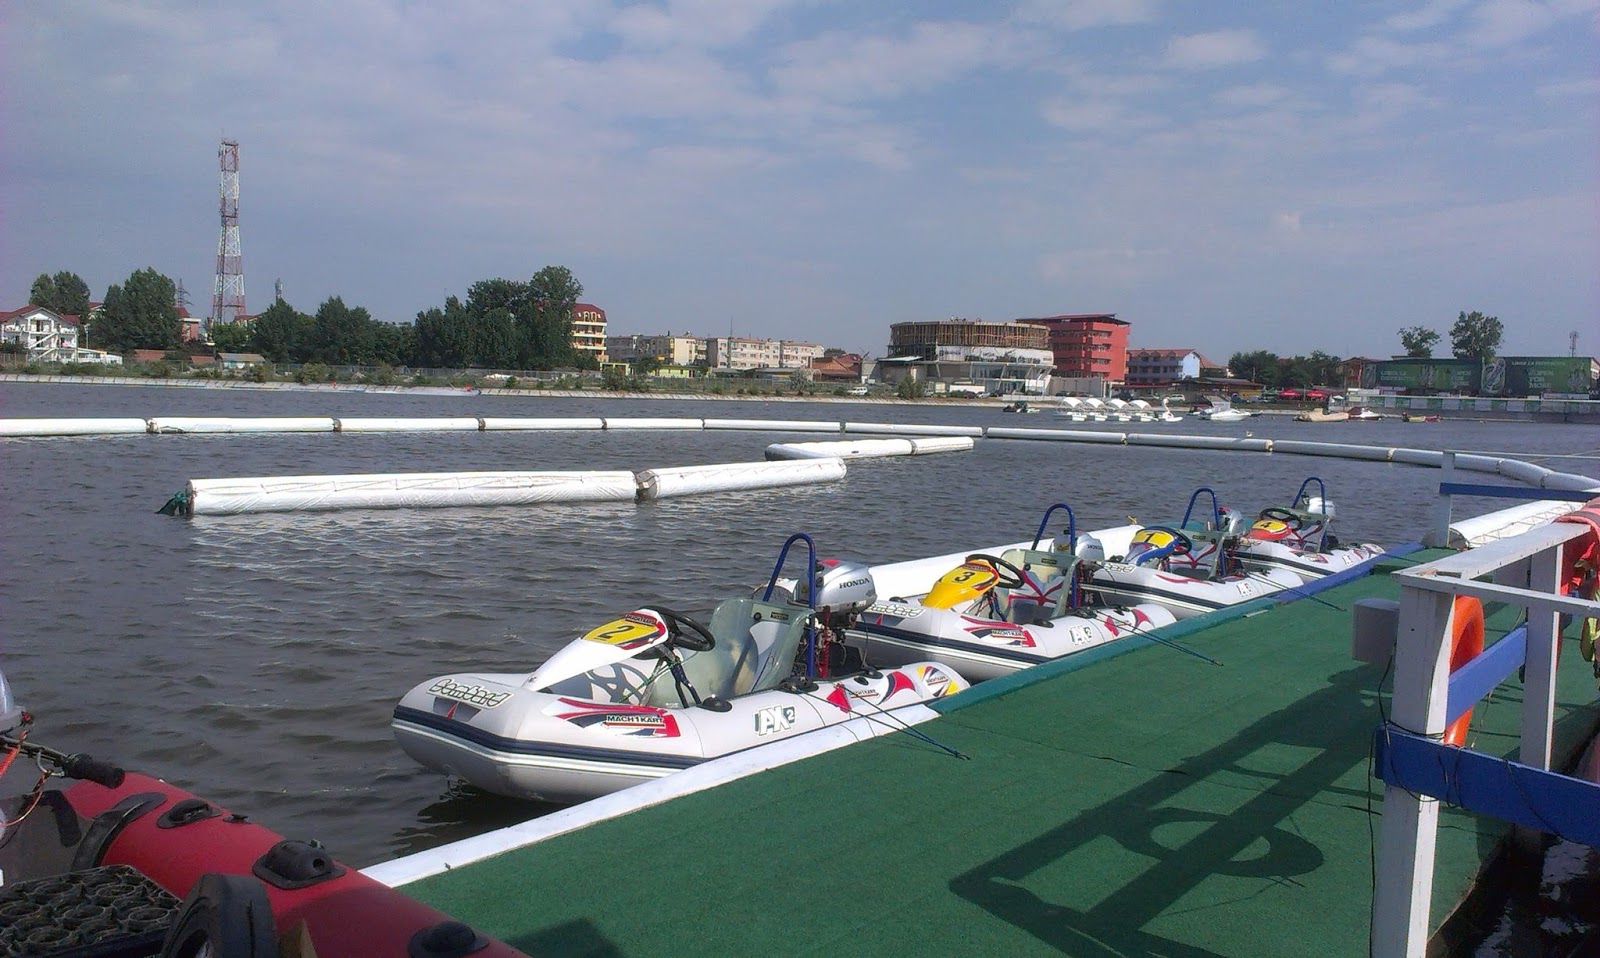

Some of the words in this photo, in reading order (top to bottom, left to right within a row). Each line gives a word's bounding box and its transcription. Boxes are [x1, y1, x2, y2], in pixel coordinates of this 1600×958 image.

[955, 571, 976, 582] 3
[839, 577, 870, 589] HONDA
[597, 625, 635, 640] 2
